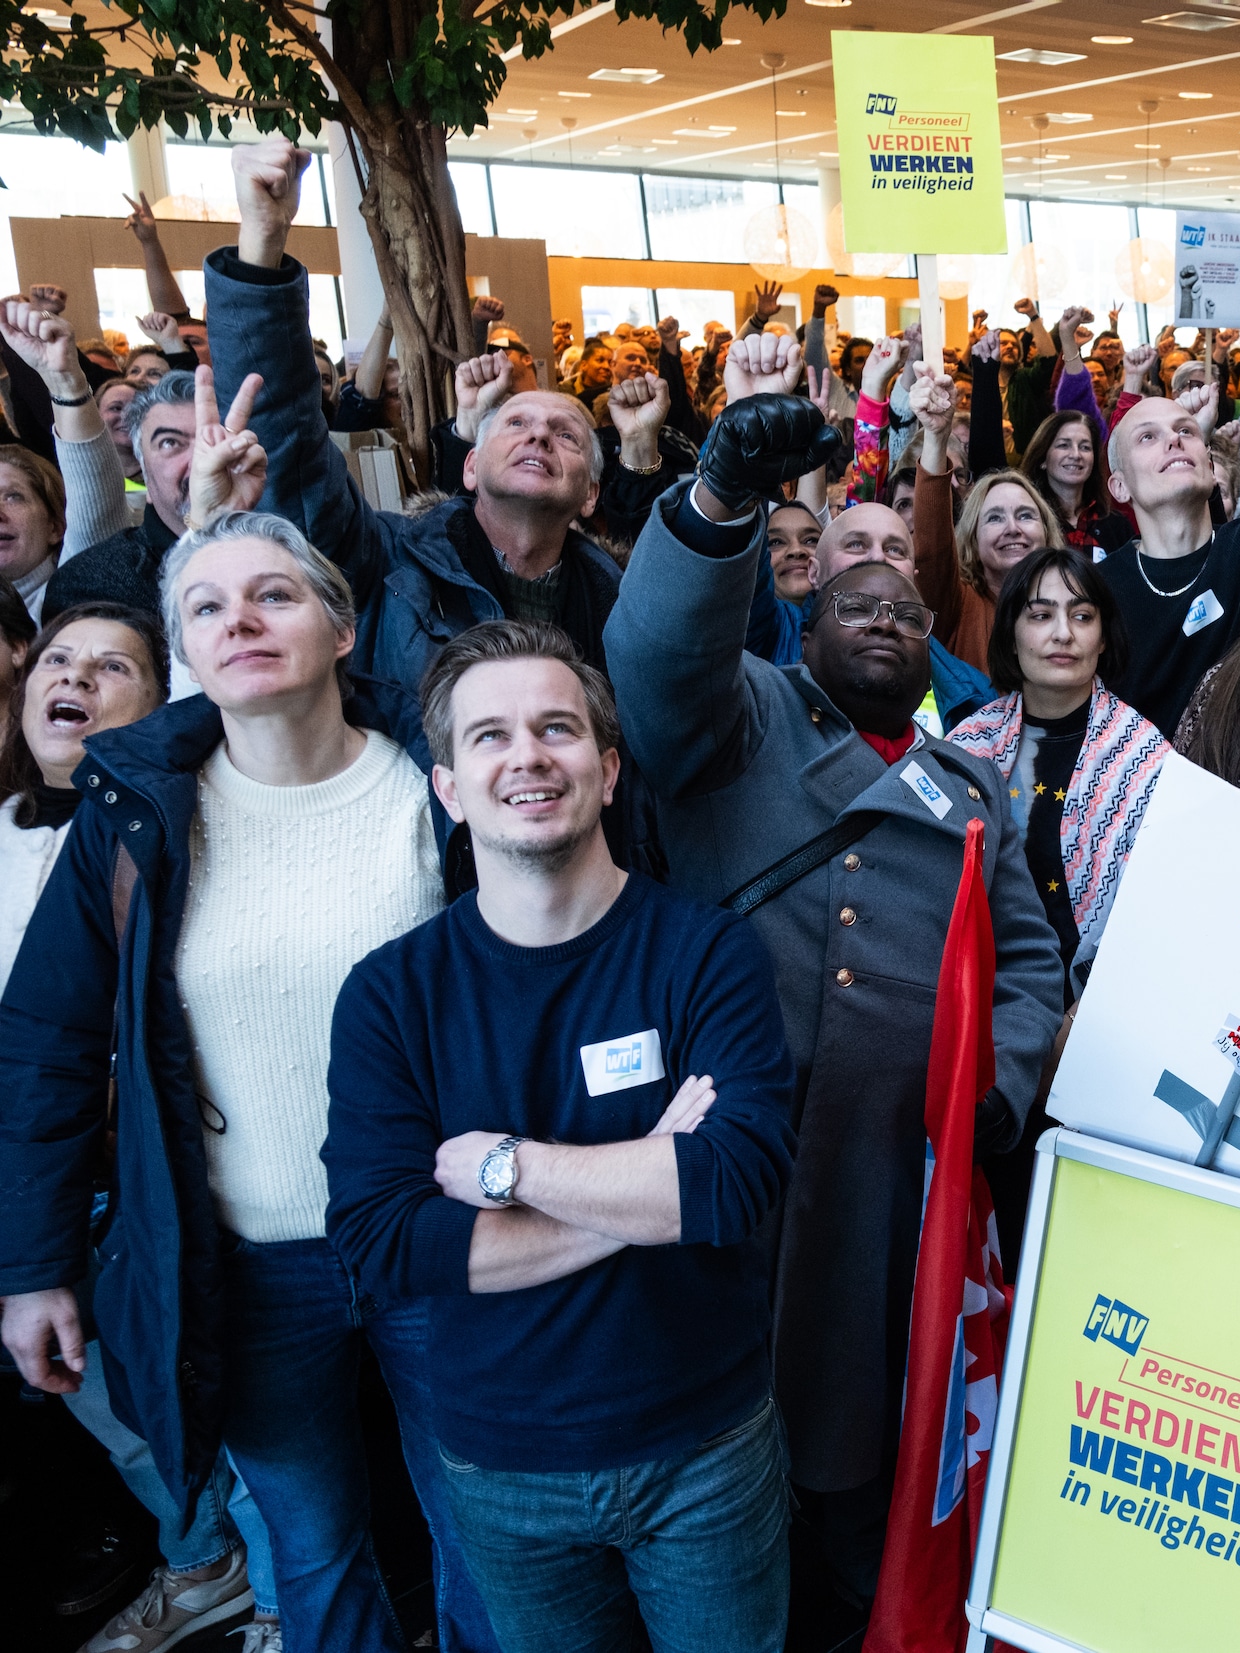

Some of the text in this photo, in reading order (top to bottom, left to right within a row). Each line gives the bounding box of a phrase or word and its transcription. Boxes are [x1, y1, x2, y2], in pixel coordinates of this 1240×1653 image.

[866, 95, 897, 113] FNV
[898, 115, 963, 127] Personeel
[867, 134, 973, 152] VERDIENT
[870, 154, 974, 174] WERKEN
[872, 175, 974, 194] in veiligheid
[1181, 227, 1205, 245] WTF
[606, 1046, 641, 1072] WTF
[1085, 1299, 1149, 1351] FNV
[1059, 1470, 1091, 1506] in
